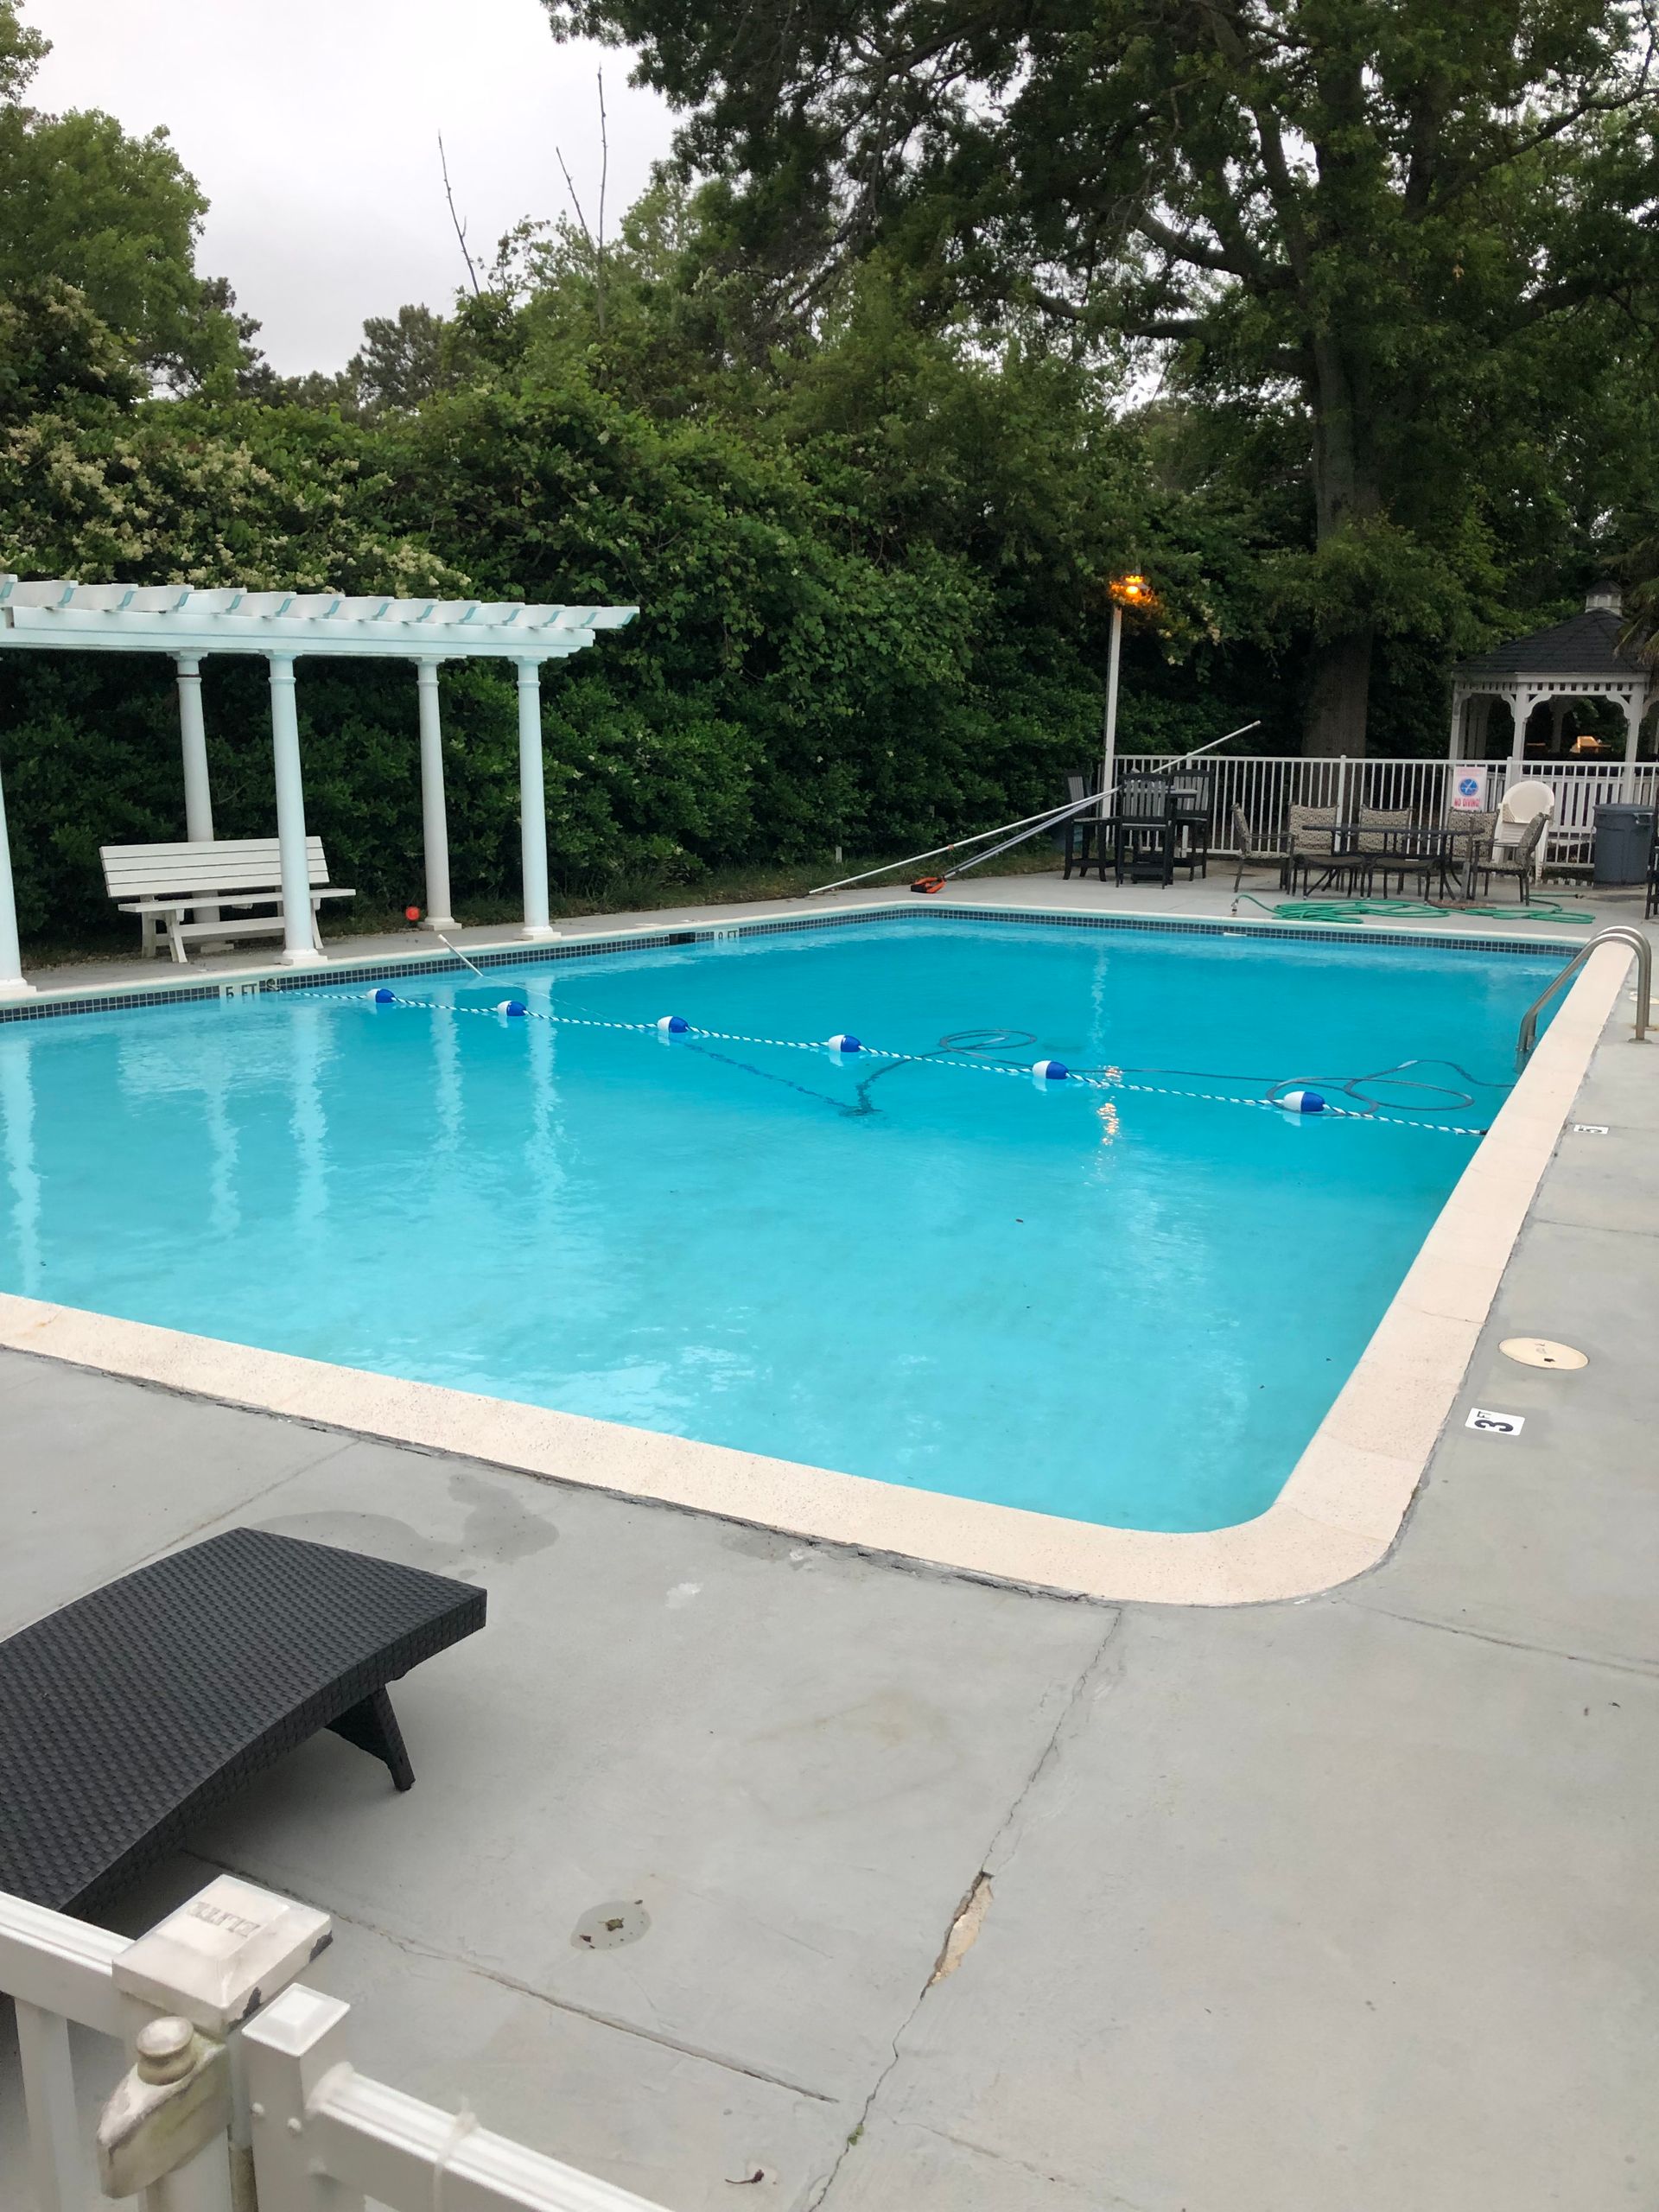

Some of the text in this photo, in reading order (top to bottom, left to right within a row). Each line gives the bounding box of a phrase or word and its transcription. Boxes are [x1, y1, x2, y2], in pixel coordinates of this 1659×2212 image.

[1453, 798, 1461, 807] NO
[226, 983, 257, 998] 5 FT
[1474, 1420, 1514, 1432] 3
